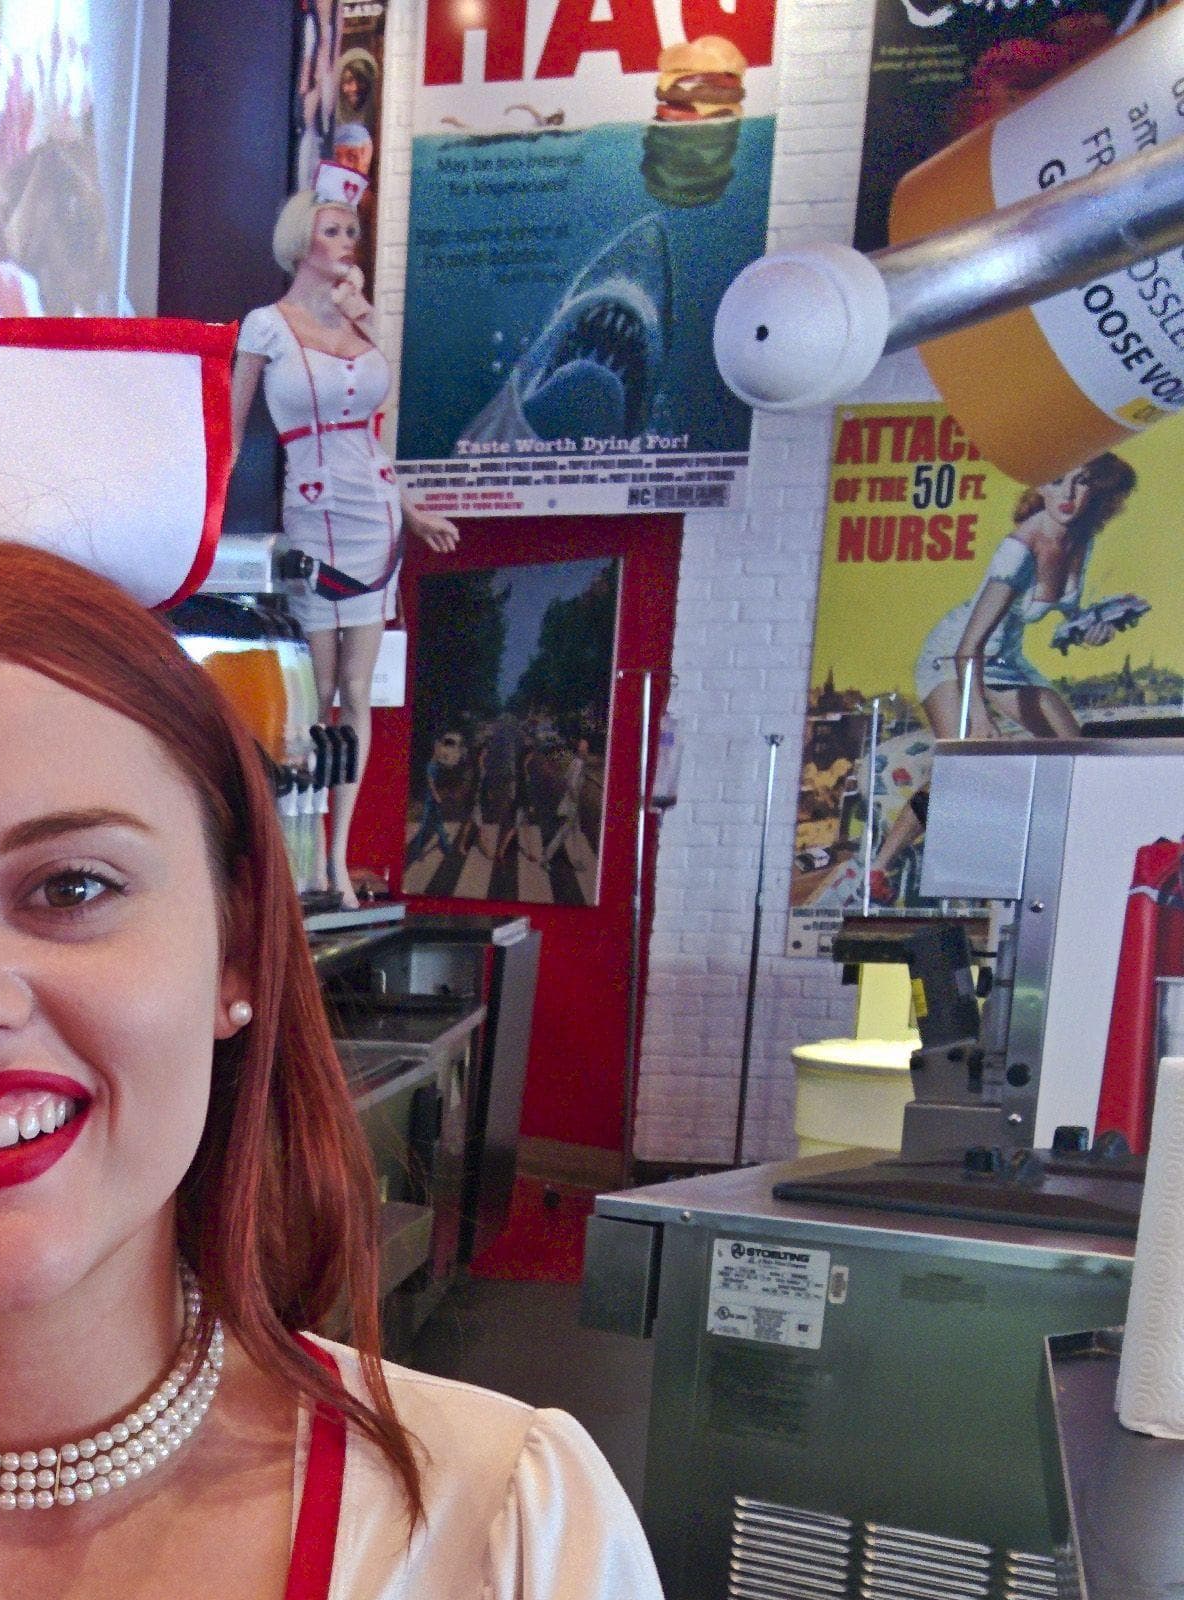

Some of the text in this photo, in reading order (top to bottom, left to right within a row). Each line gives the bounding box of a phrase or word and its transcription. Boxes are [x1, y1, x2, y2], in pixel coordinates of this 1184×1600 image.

[456, 432, 690, 455] Taste Worth Dying For!
[834, 415, 982, 465] ATTAC
[832, 476, 863, 503] OF
[866, 476, 909, 503] THE
[912, 463, 956, 509] 50
[837, 513, 979, 563] NURSE
